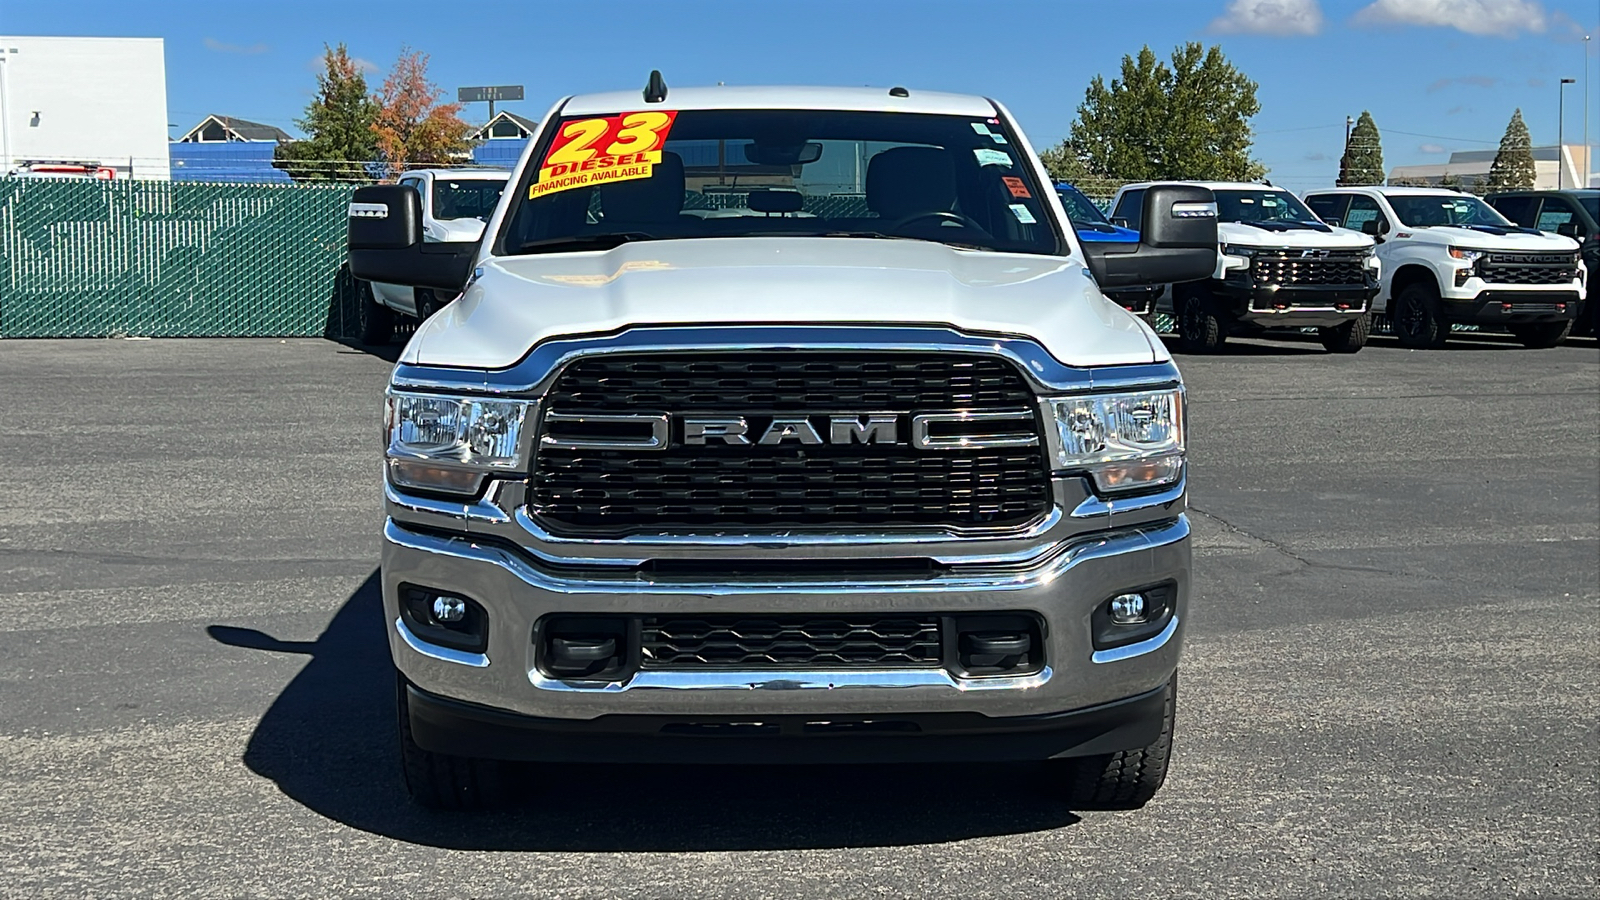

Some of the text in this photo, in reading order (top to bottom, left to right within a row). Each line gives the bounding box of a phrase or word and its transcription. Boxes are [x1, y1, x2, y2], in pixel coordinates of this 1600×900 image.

[547, 112, 671, 164] 23
[550, 152, 650, 177] DIESEL
[532, 166, 648, 195] FINANCING AVAILABLE
[683, 415, 898, 444] RAM
